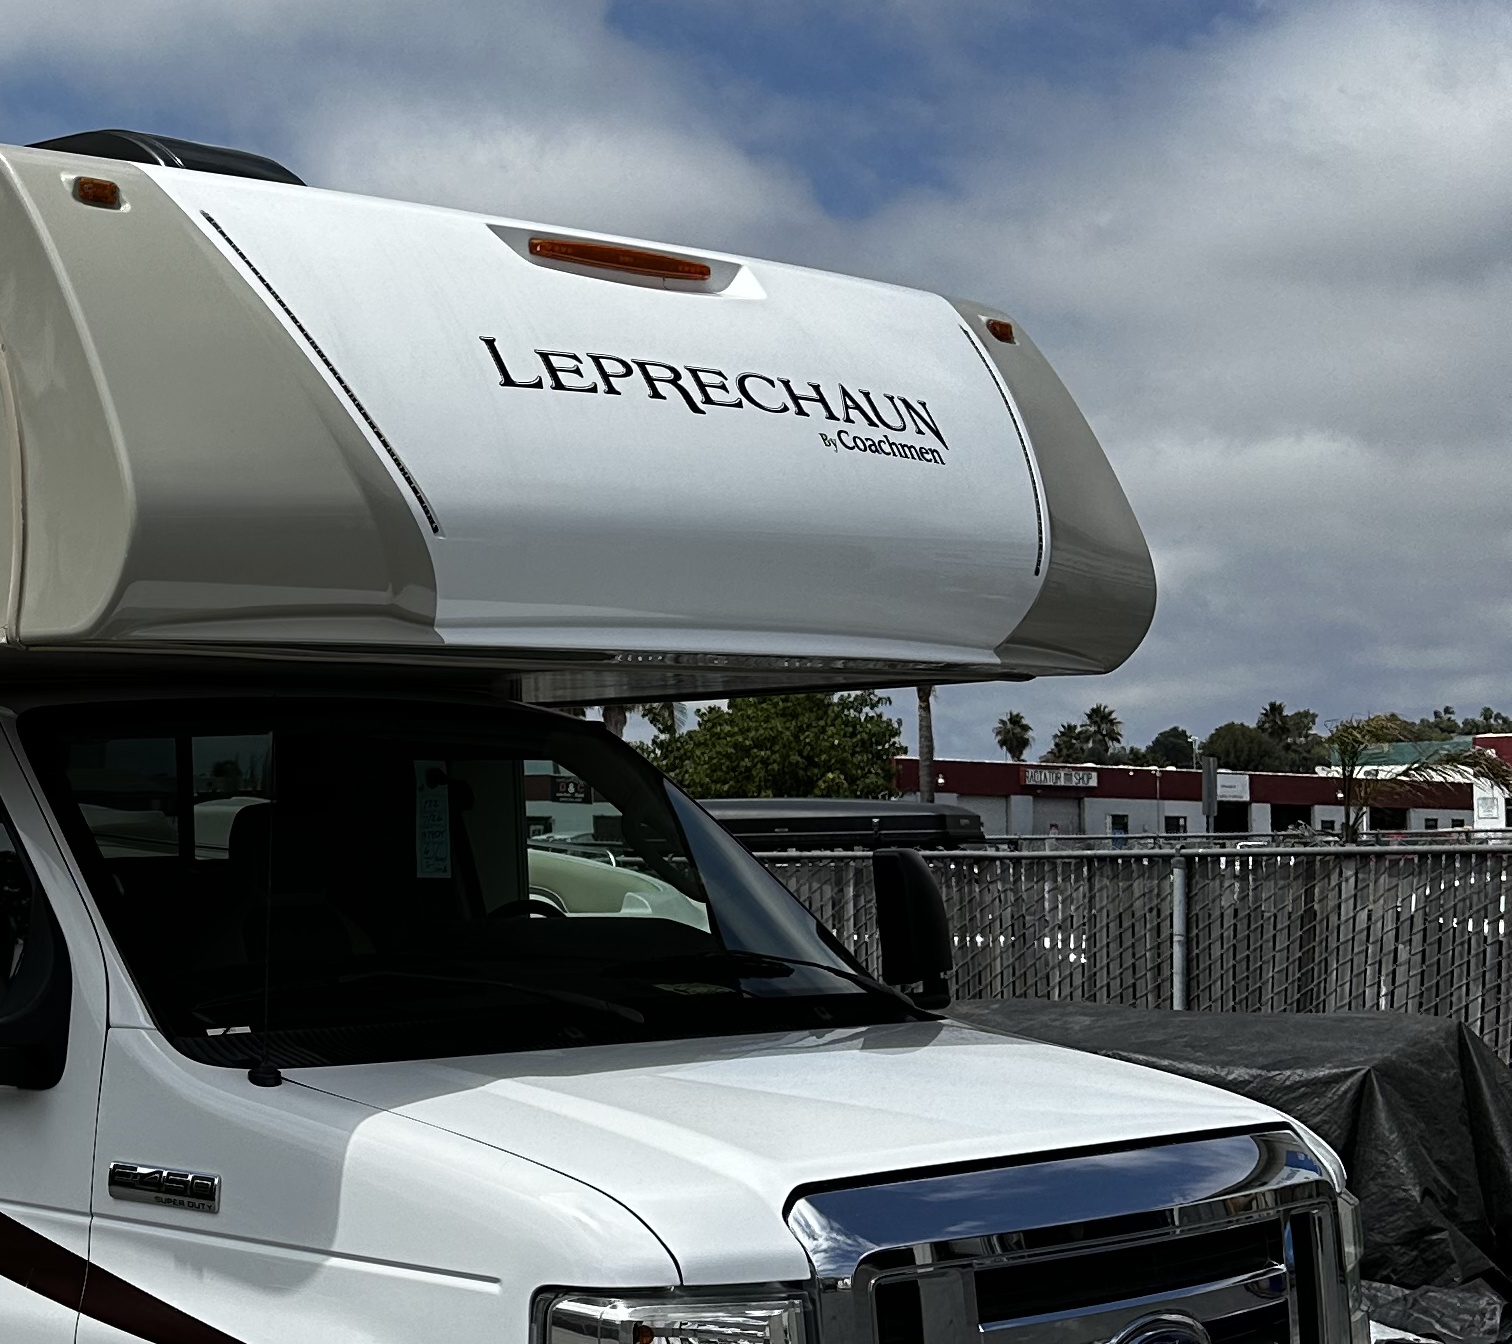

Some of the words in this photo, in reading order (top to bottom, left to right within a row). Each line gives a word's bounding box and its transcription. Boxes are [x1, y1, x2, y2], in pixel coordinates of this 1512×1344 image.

[479, 336, 949, 450] LEPRECHAUN
[818, 432, 838, 453] By
[837, 429, 946, 465] Coachmen
[153, 1195, 185, 1207] SUPER
[187, 1201, 213, 1211] DUTY
